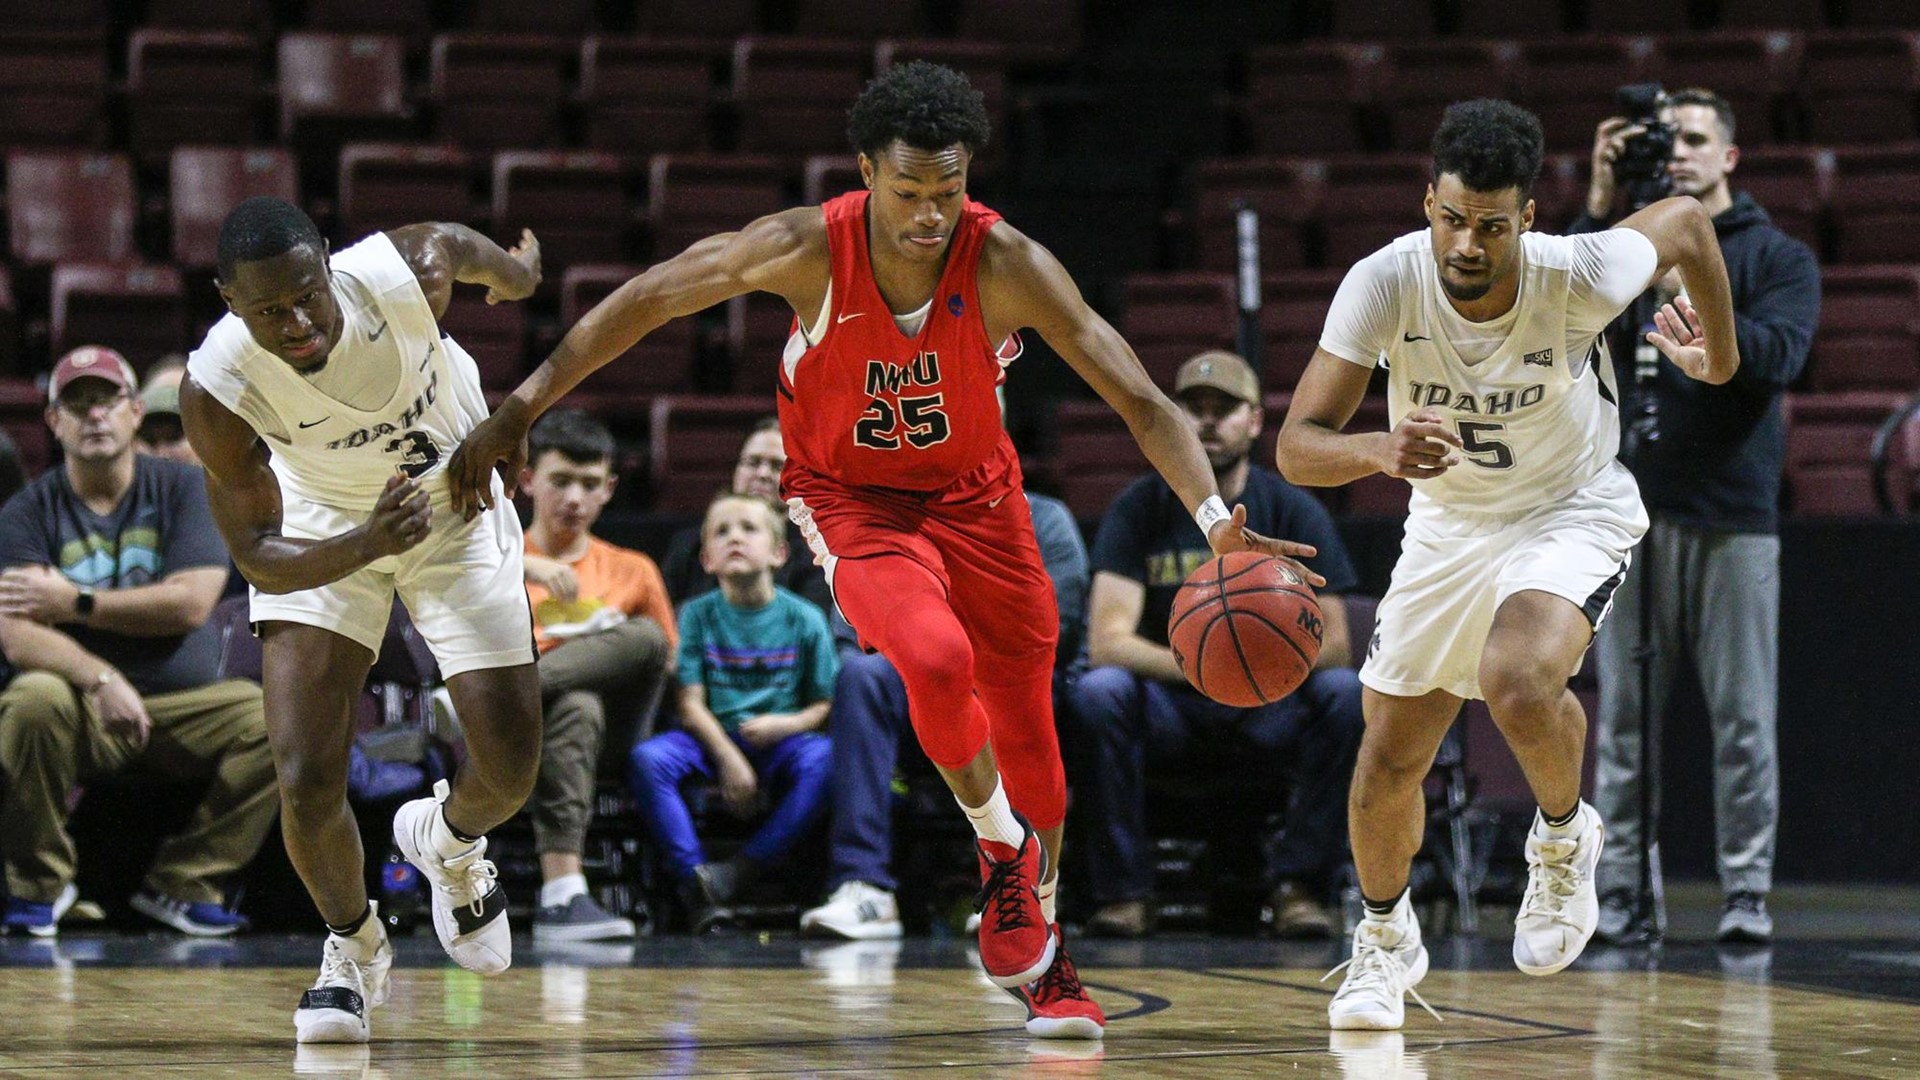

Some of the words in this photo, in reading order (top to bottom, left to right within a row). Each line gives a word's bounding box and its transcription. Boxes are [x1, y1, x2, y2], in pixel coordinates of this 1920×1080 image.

[325, 370, 438, 450] IDAHO
[854, 392, 951, 450] 25
[1409, 380, 1546, 415] IDAHO
[382, 430, 443, 479] 3
[1455, 419, 1517, 471] 5
